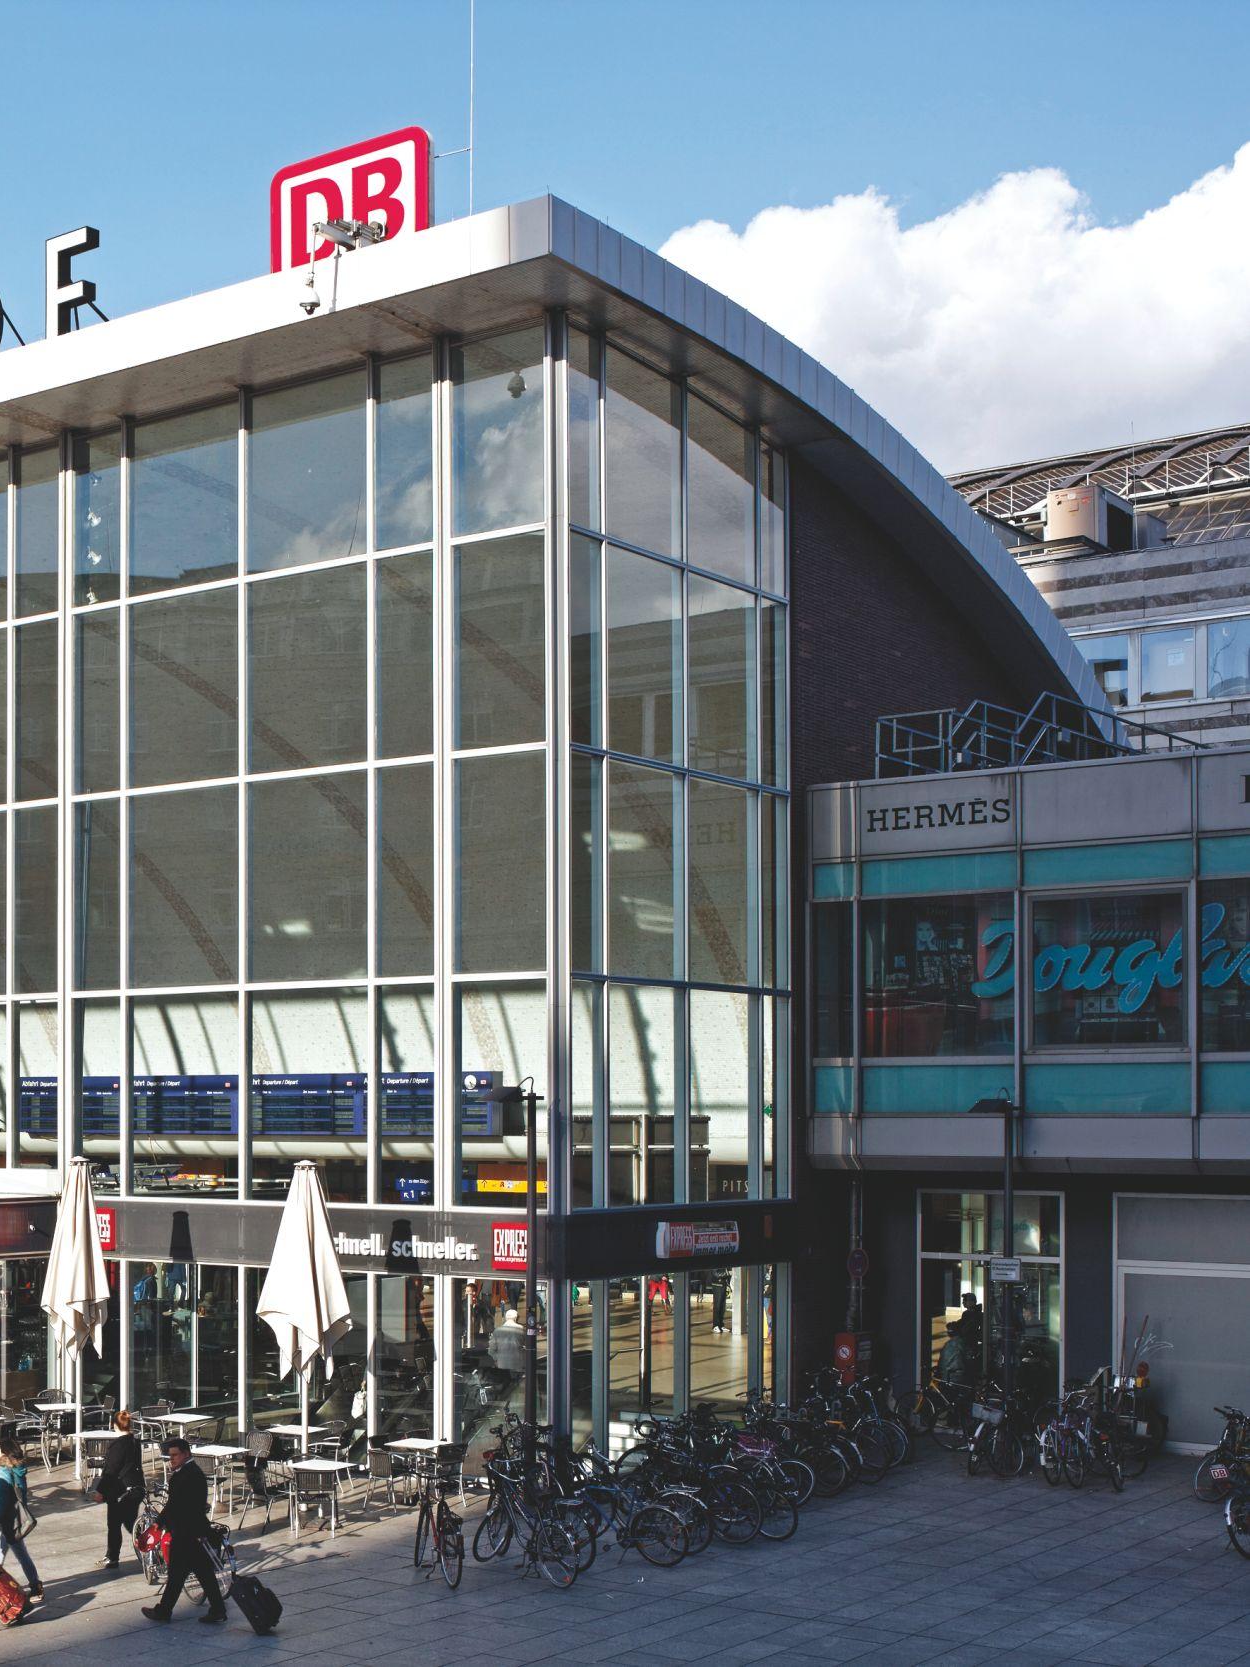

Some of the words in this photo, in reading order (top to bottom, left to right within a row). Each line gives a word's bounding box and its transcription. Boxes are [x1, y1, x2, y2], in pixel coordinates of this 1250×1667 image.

[291, 157, 405, 268] DB
[333, 1231, 386, 1256] chnell.
[391, 1235, 480, 1261] schneller.
